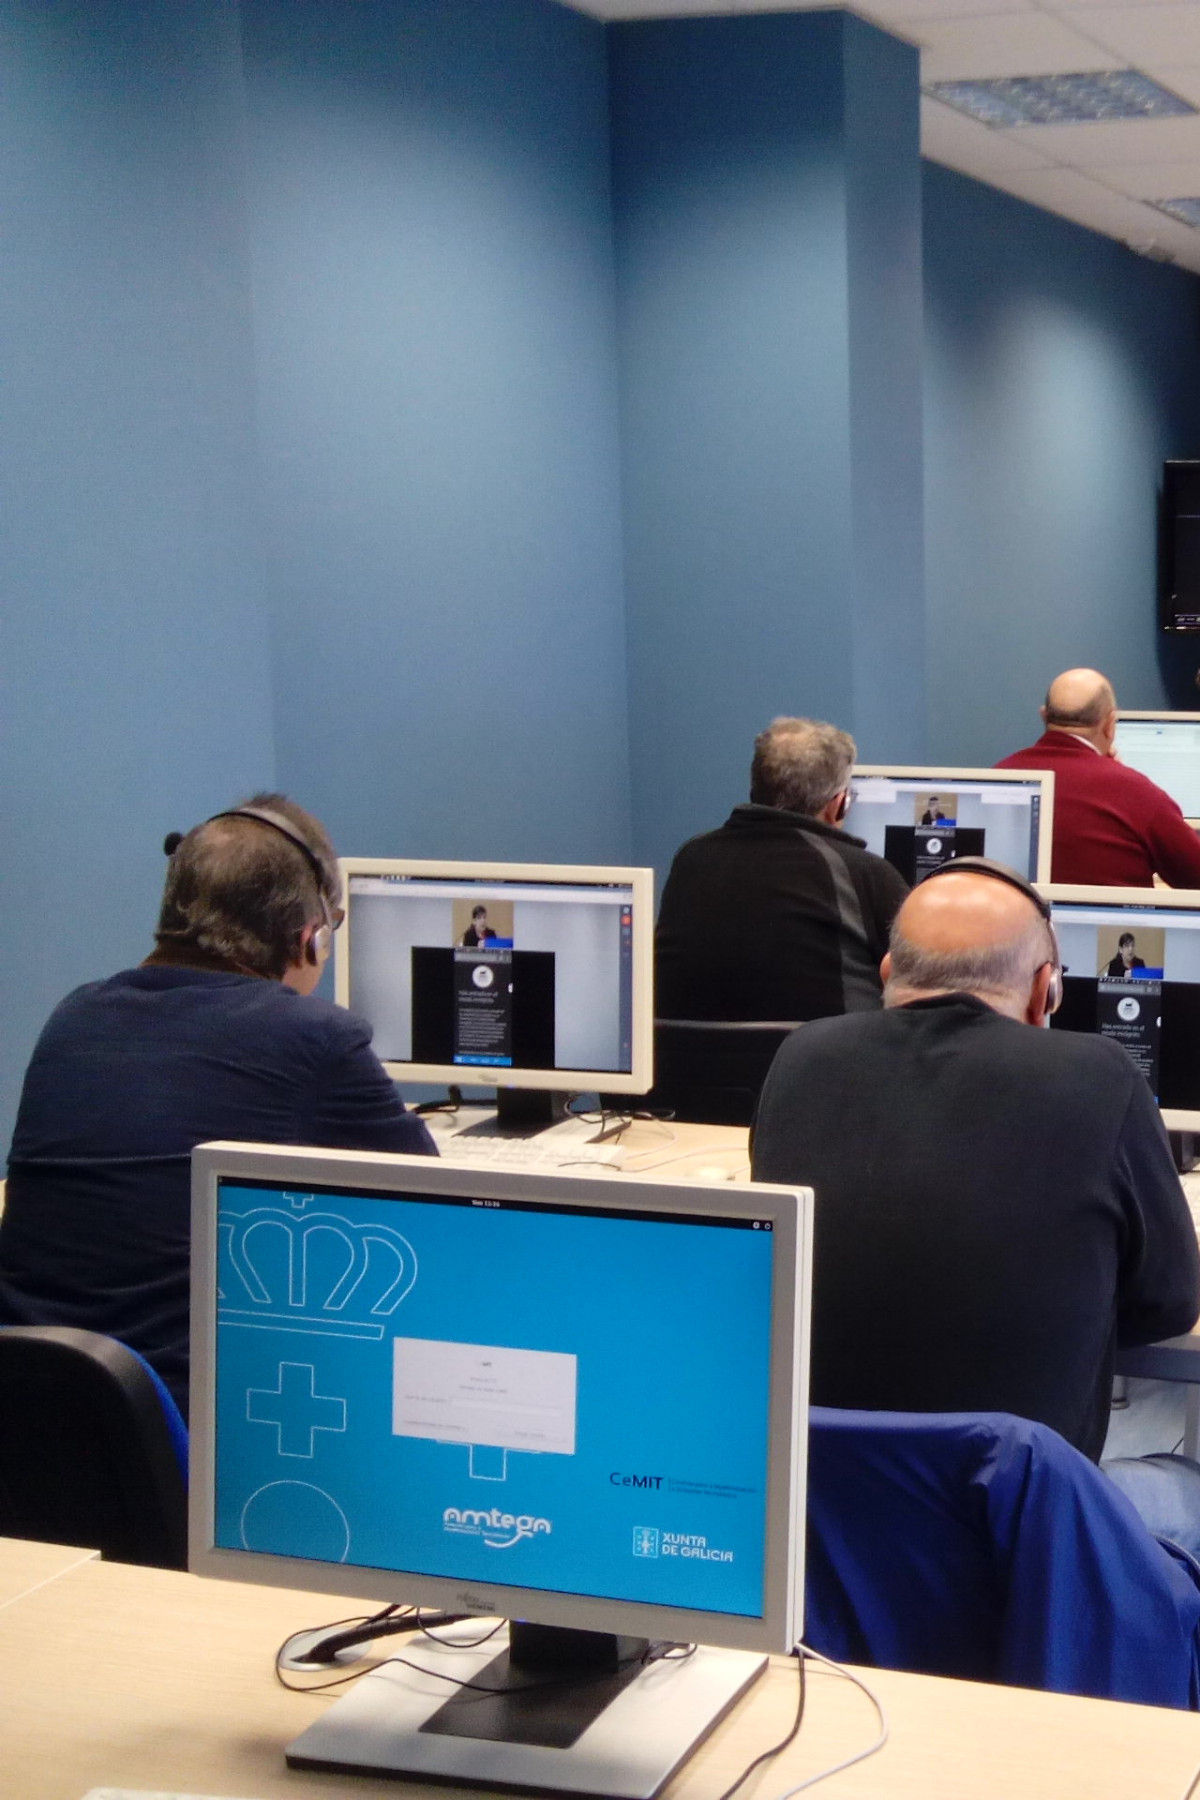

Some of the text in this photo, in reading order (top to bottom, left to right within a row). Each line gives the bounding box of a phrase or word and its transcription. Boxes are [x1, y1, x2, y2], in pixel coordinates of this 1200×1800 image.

[610, 1472, 663, 1490] CeMIT
[662, 1532, 707, 1548] XUNTA
[662, 1544, 734, 1563] DE GALICIA
